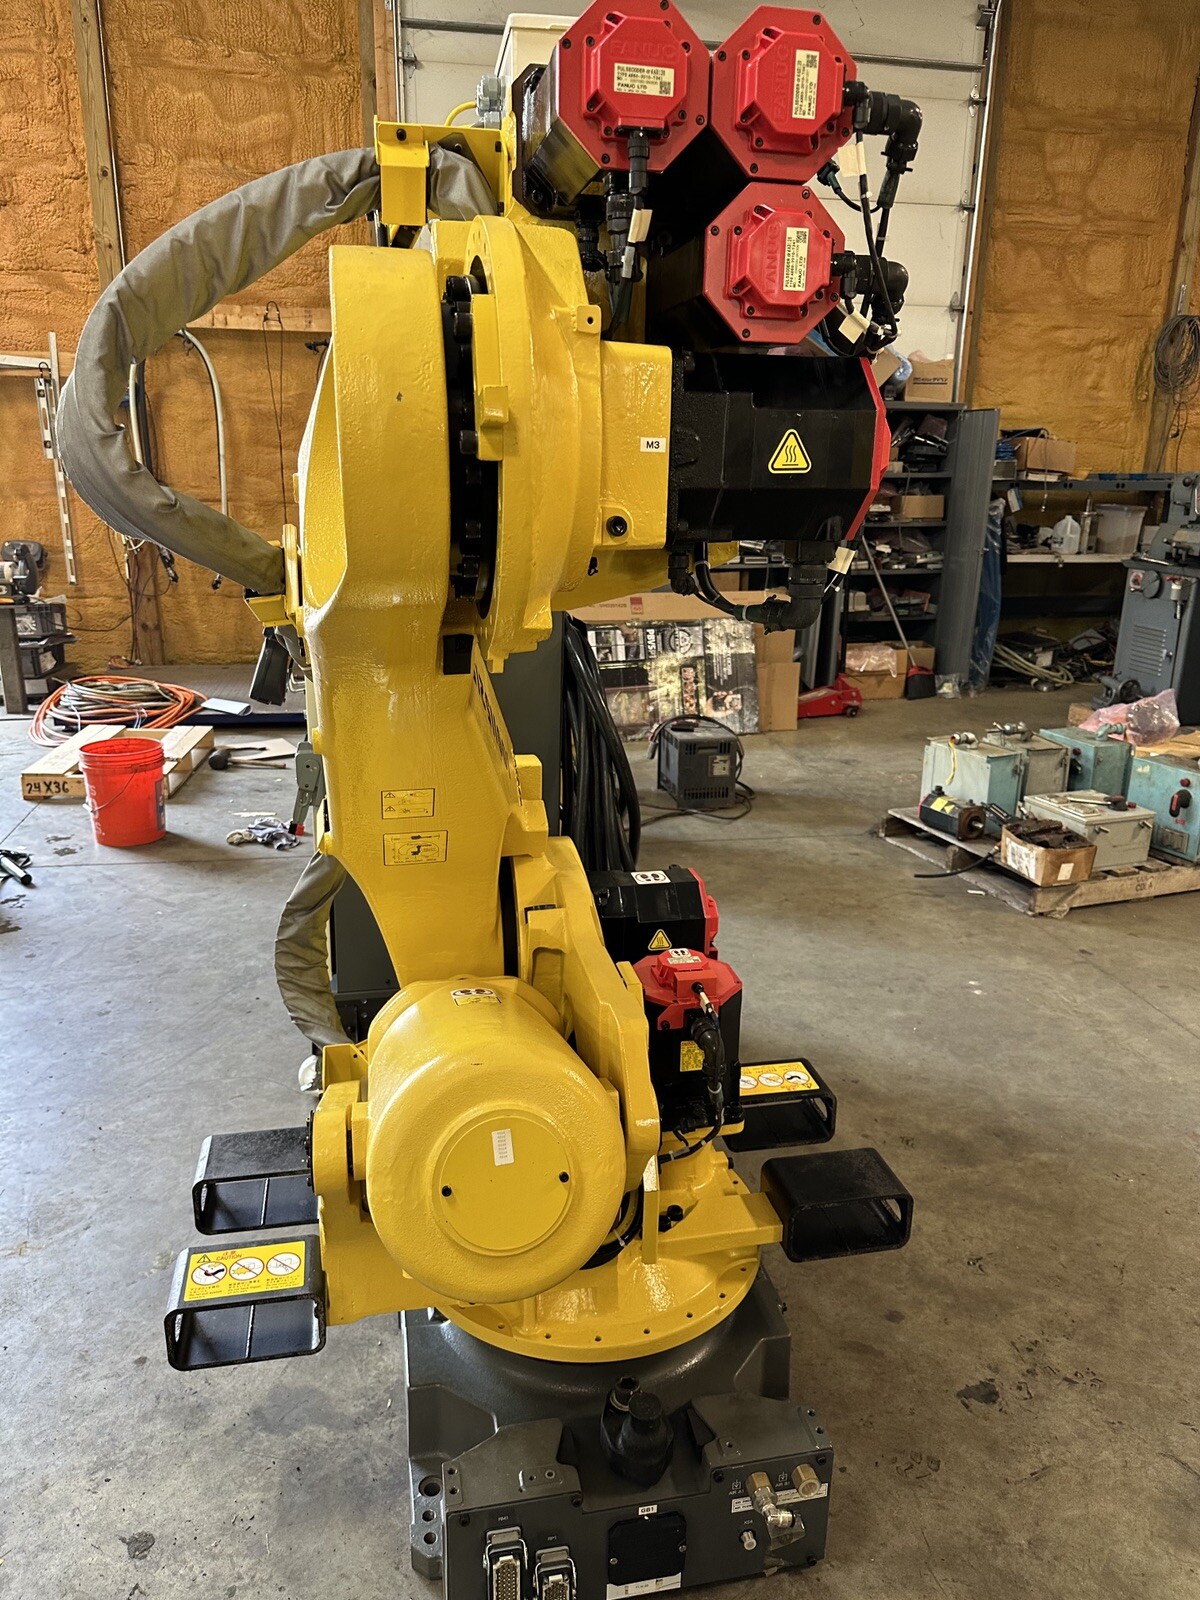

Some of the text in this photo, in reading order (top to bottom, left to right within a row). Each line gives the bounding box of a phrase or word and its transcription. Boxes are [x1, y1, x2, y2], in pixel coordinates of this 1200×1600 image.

[763, 222, 780, 294] FANUC
[646, 440, 660, 449] M3
[216, 1253, 242, 1261] CAUTION
